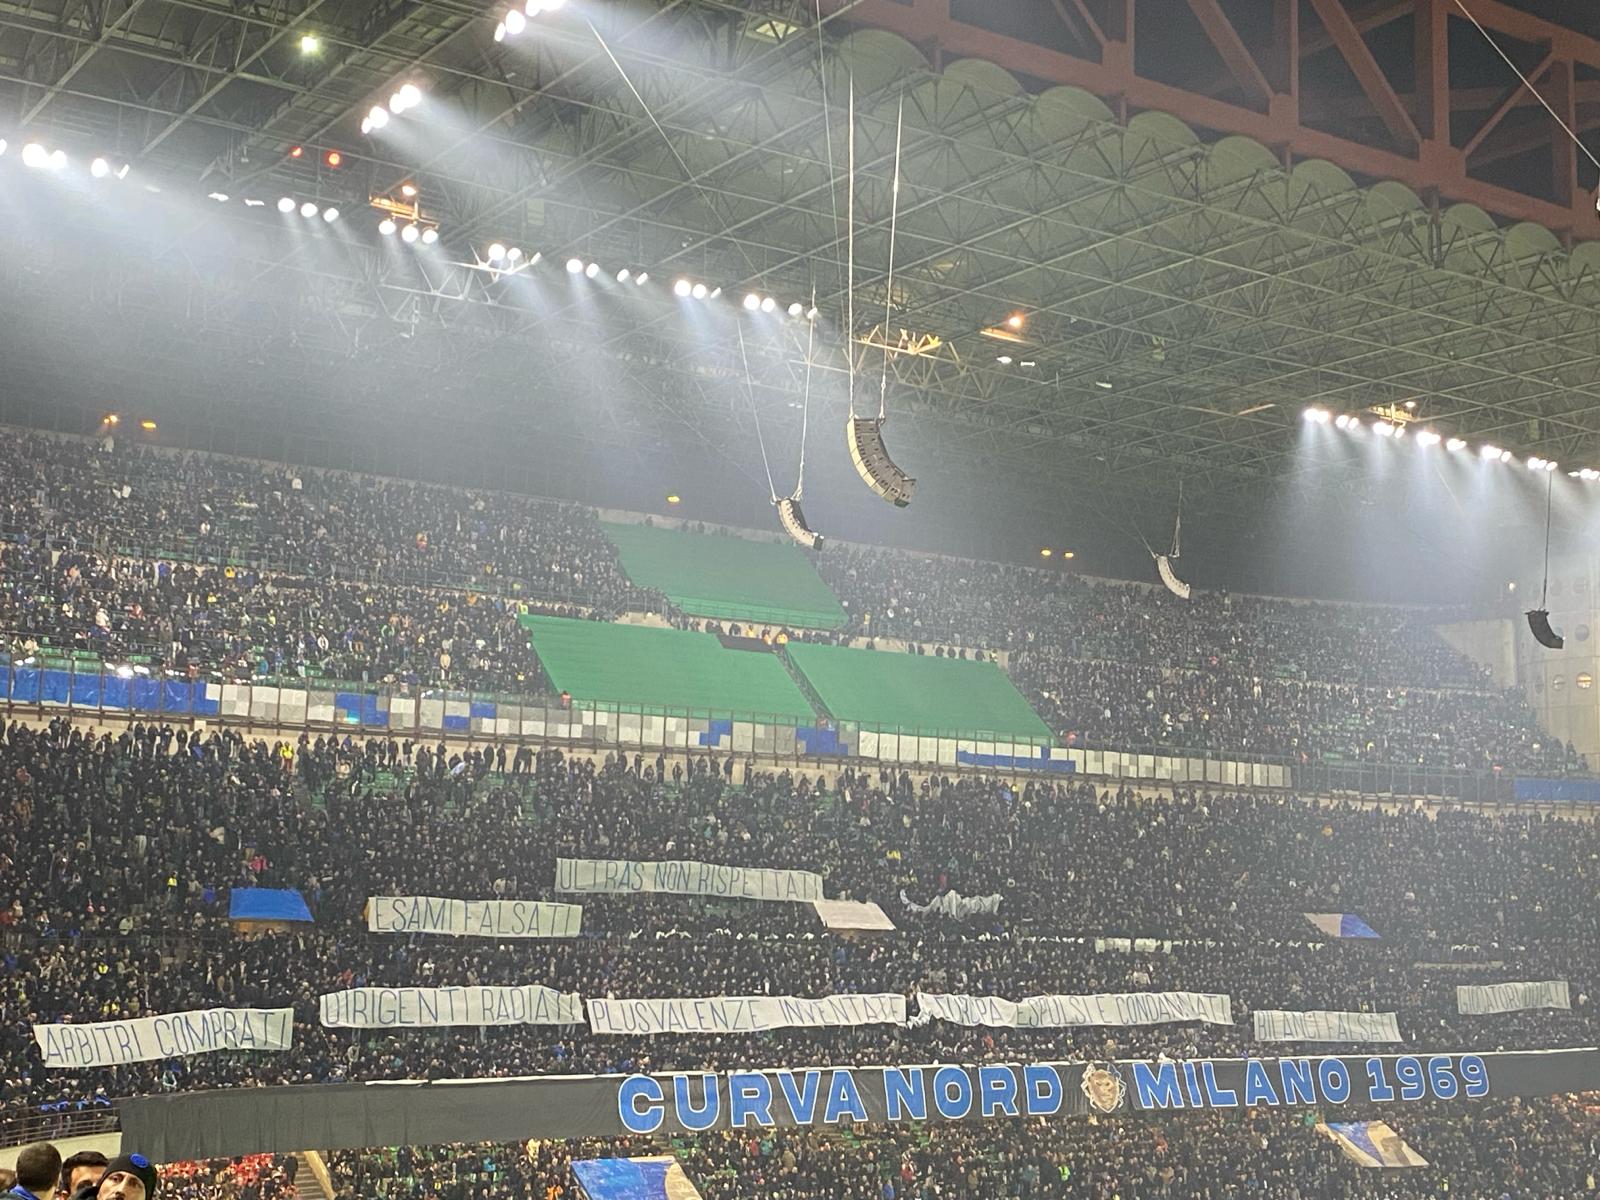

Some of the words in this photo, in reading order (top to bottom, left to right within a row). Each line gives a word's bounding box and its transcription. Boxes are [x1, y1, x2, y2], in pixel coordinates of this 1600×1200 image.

[559, 860, 645, 891] ULTRAS
[653, 862, 691, 891] NON
[699, 864, 819, 900] RISPETTATI
[375, 896, 453, 932] ESAMI
[463, 900, 571, 937] FALSATI
[324, 988, 469, 1025] DIRIGENTI
[481, 987, 576, 1022] RADIATI
[592, 999, 770, 1032] PLUSVALENZE
[778, 996, 907, 1025] INVENTATE
[1016, 996, 1093, 1027] ESPULSI
[1095, 995, 1112, 1024] E
[46, 1023, 143, 1065] ARBITRI
[153, 1010, 286, 1057] COMPRATI
[618, 1068, 867, 1133] CURVA
[883, 1065, 1063, 1121] NORD
[1132, 1058, 1351, 1109] MILANO
[1365, 1055, 1490, 1102] 1969
